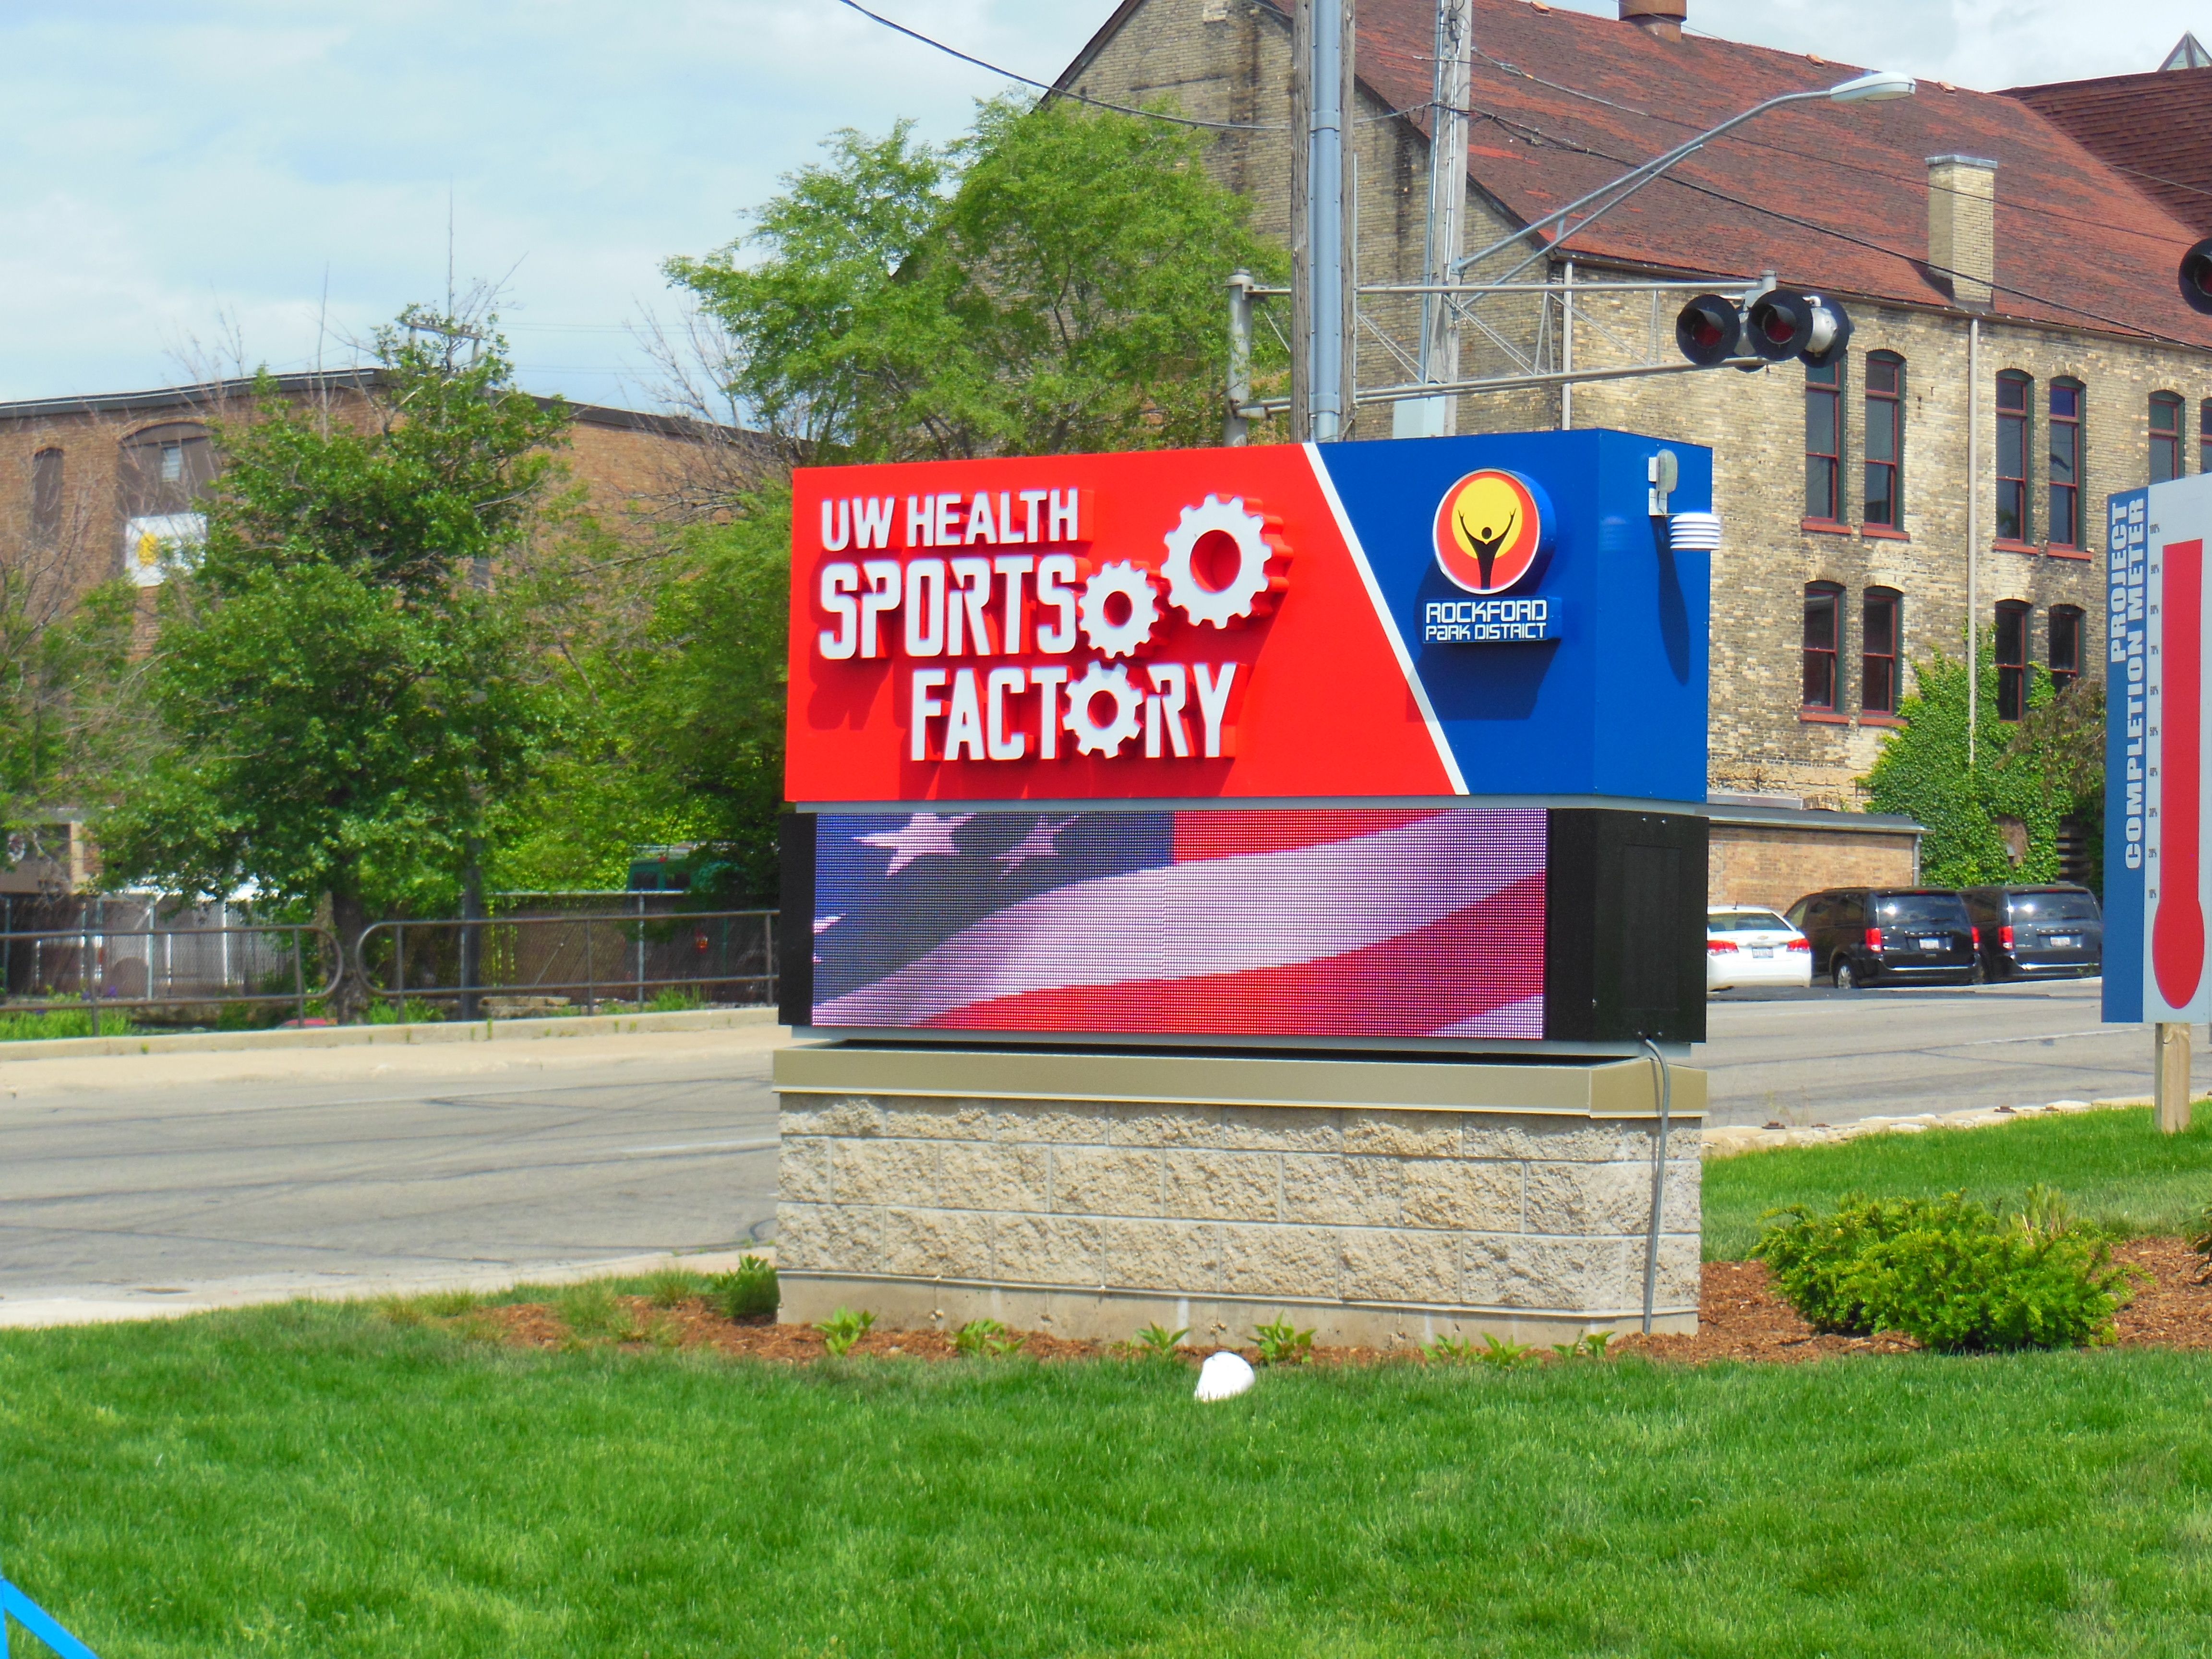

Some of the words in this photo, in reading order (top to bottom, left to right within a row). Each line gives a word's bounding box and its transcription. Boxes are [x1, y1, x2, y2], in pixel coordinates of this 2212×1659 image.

[821, 497, 895, 552] UW
[906, 488, 1079, 547] HEALTH
[2128, 498, 2144, 621] METER
[819, 553, 1077, 660] SPORTS
[1426, 600, 1547, 624] ROCKFORD
[1474, 623, 1547, 640] DISTRICT
[2110, 502, 2127, 662] PROJECT
[911, 660, 1237, 761] FACTORY
[2125, 630, 2143, 869] COMPLETION
